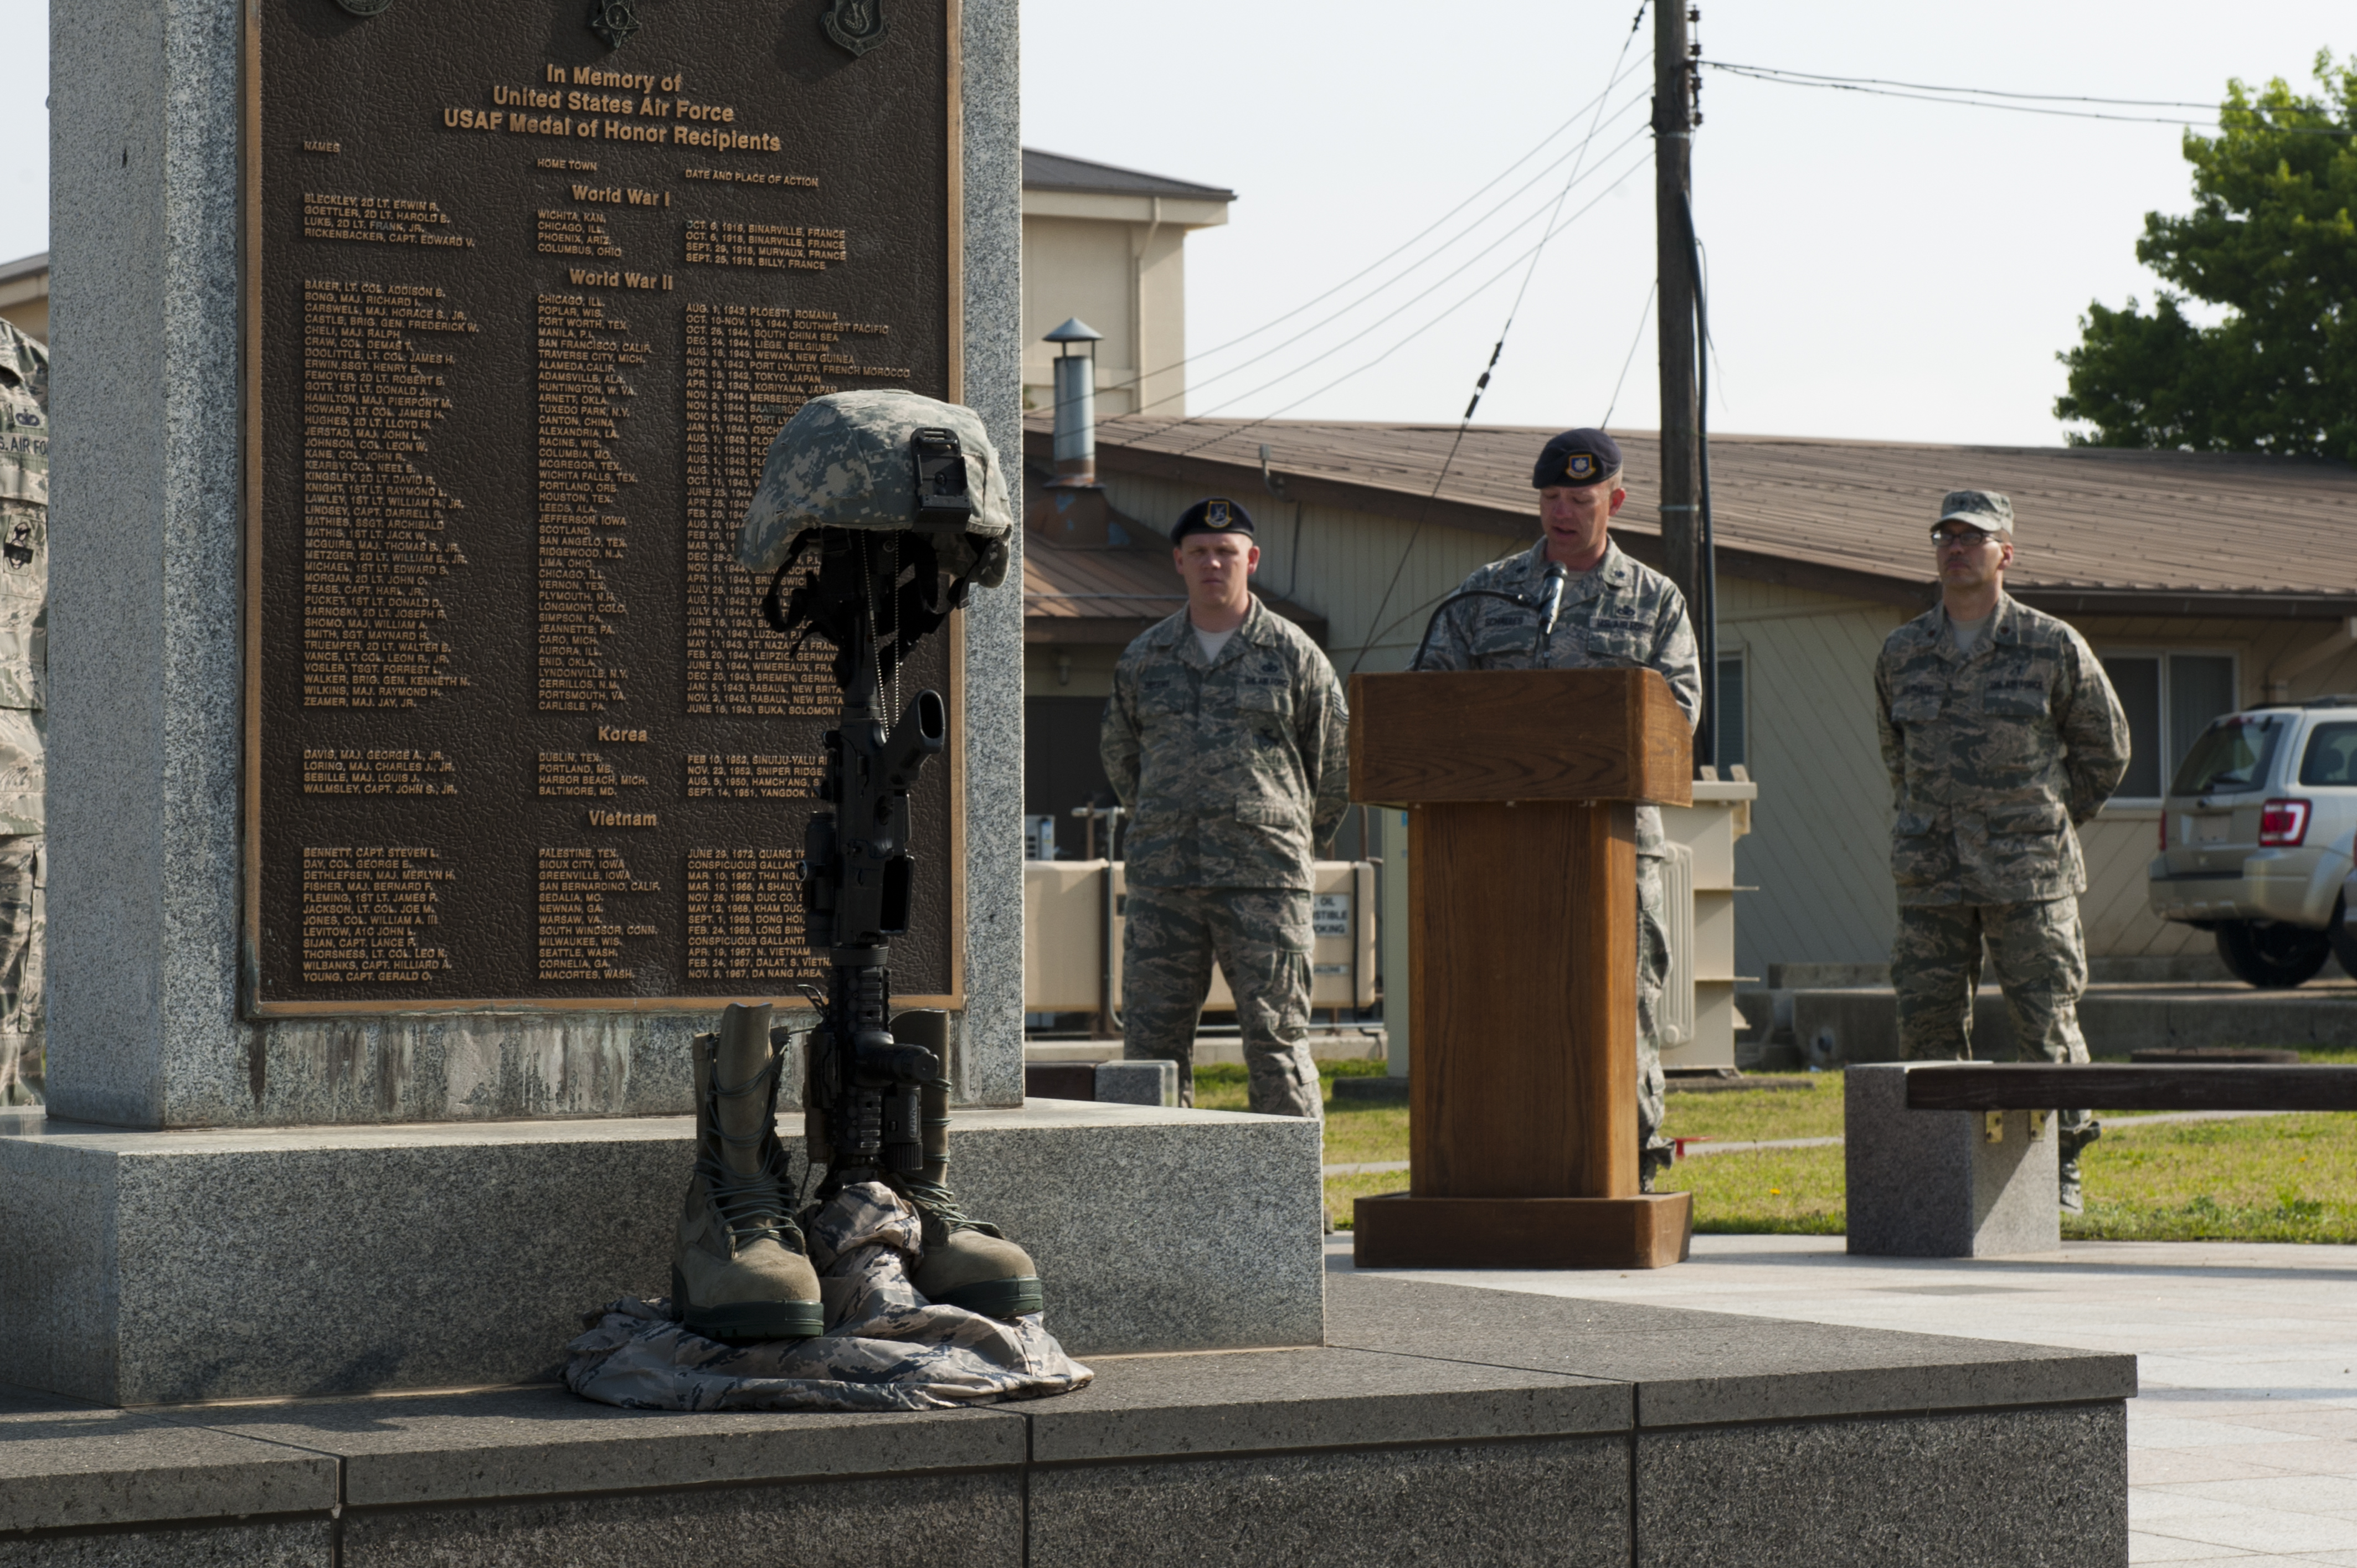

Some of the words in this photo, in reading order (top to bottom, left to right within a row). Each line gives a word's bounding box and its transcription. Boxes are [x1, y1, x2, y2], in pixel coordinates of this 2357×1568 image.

[547, 64, 566, 83] In
[573, 66, 655, 94] Memory
[661, 74, 682, 92] of
[493, 85, 561, 109] United
[568, 91, 633, 114] States
[640, 97, 670, 117] Air
[676, 100, 734, 122] Force
[444, 109, 503, 130] USAF
[510, 113, 570, 136] Medal
[577, 118, 599, 138] of
[605, 120, 668, 143] Honor
[674, 126, 781, 152] Recipients
[303, 141, 341, 153] NAMES
[537, 158, 566, 169] HOME
[568, 160, 599, 172] TOWN
[685, 169, 710, 179] DATE
[712, 170, 733, 180] AND
[735, 172, 765, 183] PLACE
[768, 174, 781, 184] OF
[783, 176, 820, 187] ACTION
[572, 184, 621, 203] World
[627, 188, 658, 205] War
[665, 192, 670, 207] I
[305, 228, 386, 243] RICKENBACKER,
[420, 235, 463, 246] EDWARD
[710, 233, 718, 243] 6,
[748, 235, 805, 249] BINARVILLE,
[807, 239, 846, 250] FRANCE
[538, 243, 594, 256] COLUMBUS,
[597, 247, 622, 257] OHIO
[715, 254, 729, 265] 25,
[758, 257, 785, 268] BILLY,
[788, 259, 826, 269] FRANCE
[569, 268, 619, 287] World
[624, 272, 657, 288] War
[662, 274, 673, 290] II
[305, 327, 338, 338] CHELI,
[367, 329, 400, 339] RALPH
[538, 349, 588, 360] TRAVERSE
[591, 352, 615, 363] CITY,
[538, 372, 601, 384] ADAMSVILLE,
[728, 370, 752, 381] 1942,
[754, 372, 789, 383] TOKYO,
[792, 374, 821, 384] JAPAN
[538, 415, 580, 427] CANTON,
[584, 417, 615, 427] CHINA
[538, 426, 601, 439] ALEXANDRIA,
[11, 437, 30, 453] AIR
[539, 471, 579, 481] WICHITA
[581, 472, 613, 483] FALLS,
[539, 492, 588, 504] HOUSTON,
[305, 517, 352, 528] MATHIES,
[387, 519, 445, 530] ARCHIBALD
[539, 514, 598, 525] JEFFERSON,
[601, 516, 626, 525] IOWA
[539, 525, 591, 535] SCOTLAND
[539, 547, 601, 559] RIDGEWOOD,
[538, 602, 594, 613] LONGMONT,
[538, 624, 596, 636] JEANNETTE,
[539, 690, 608, 701] PORTSMOUTH,
[303, 697, 348, 707] ZEAMER,
[378, 698, 398, 708] JAY,
[599, 725, 647, 742] Korea
[713, 766, 726, 776] 22,
[730, 766, 753, 776] 1952,
[756, 767, 790, 776] SNIPER
[794, 767, 825, 777] RIDGE,
[303, 773, 348, 783] SEBILLE,
[378, 773, 408, 782] LOUIS
[539, 786, 596, 797] BALTIMORE,
[589, 810, 657, 826] Vietnam
[539, 860, 569, 869] SIOUX
[572, 860, 595, 870] CITY,
[599, 860, 625, 869] IOWA
[303, 883, 344, 892] FISHER,
[539, 883, 559, 891] SAN
[562, 883, 627, 893] BERNARDINO,
[688, 905, 707, 913] MAY
[711, 905, 724, 915] 12,
[727, 905, 750, 915] 1968,
[754, 905, 780, 913] KHAM
[783, 905, 805, 915] DUC,
[539, 927, 572, 935] SOUTH
[575, 927, 624, 936] WINDSOR,
[1313, 924, 1345, 933] OKING
[303, 939, 336, 948] SIJAN,
[539, 938, 598, 947] MILWAUKEE,
[539, 948, 584, 958] SEATTLE,
[714, 948, 727, 958] 19,
[730, 948, 754, 958] 1967,
[769, 948, 811, 956] VIETNAM
[303, 973, 343, 982] YOUNG,
[539, 971, 600, 980] ANACORTES,
